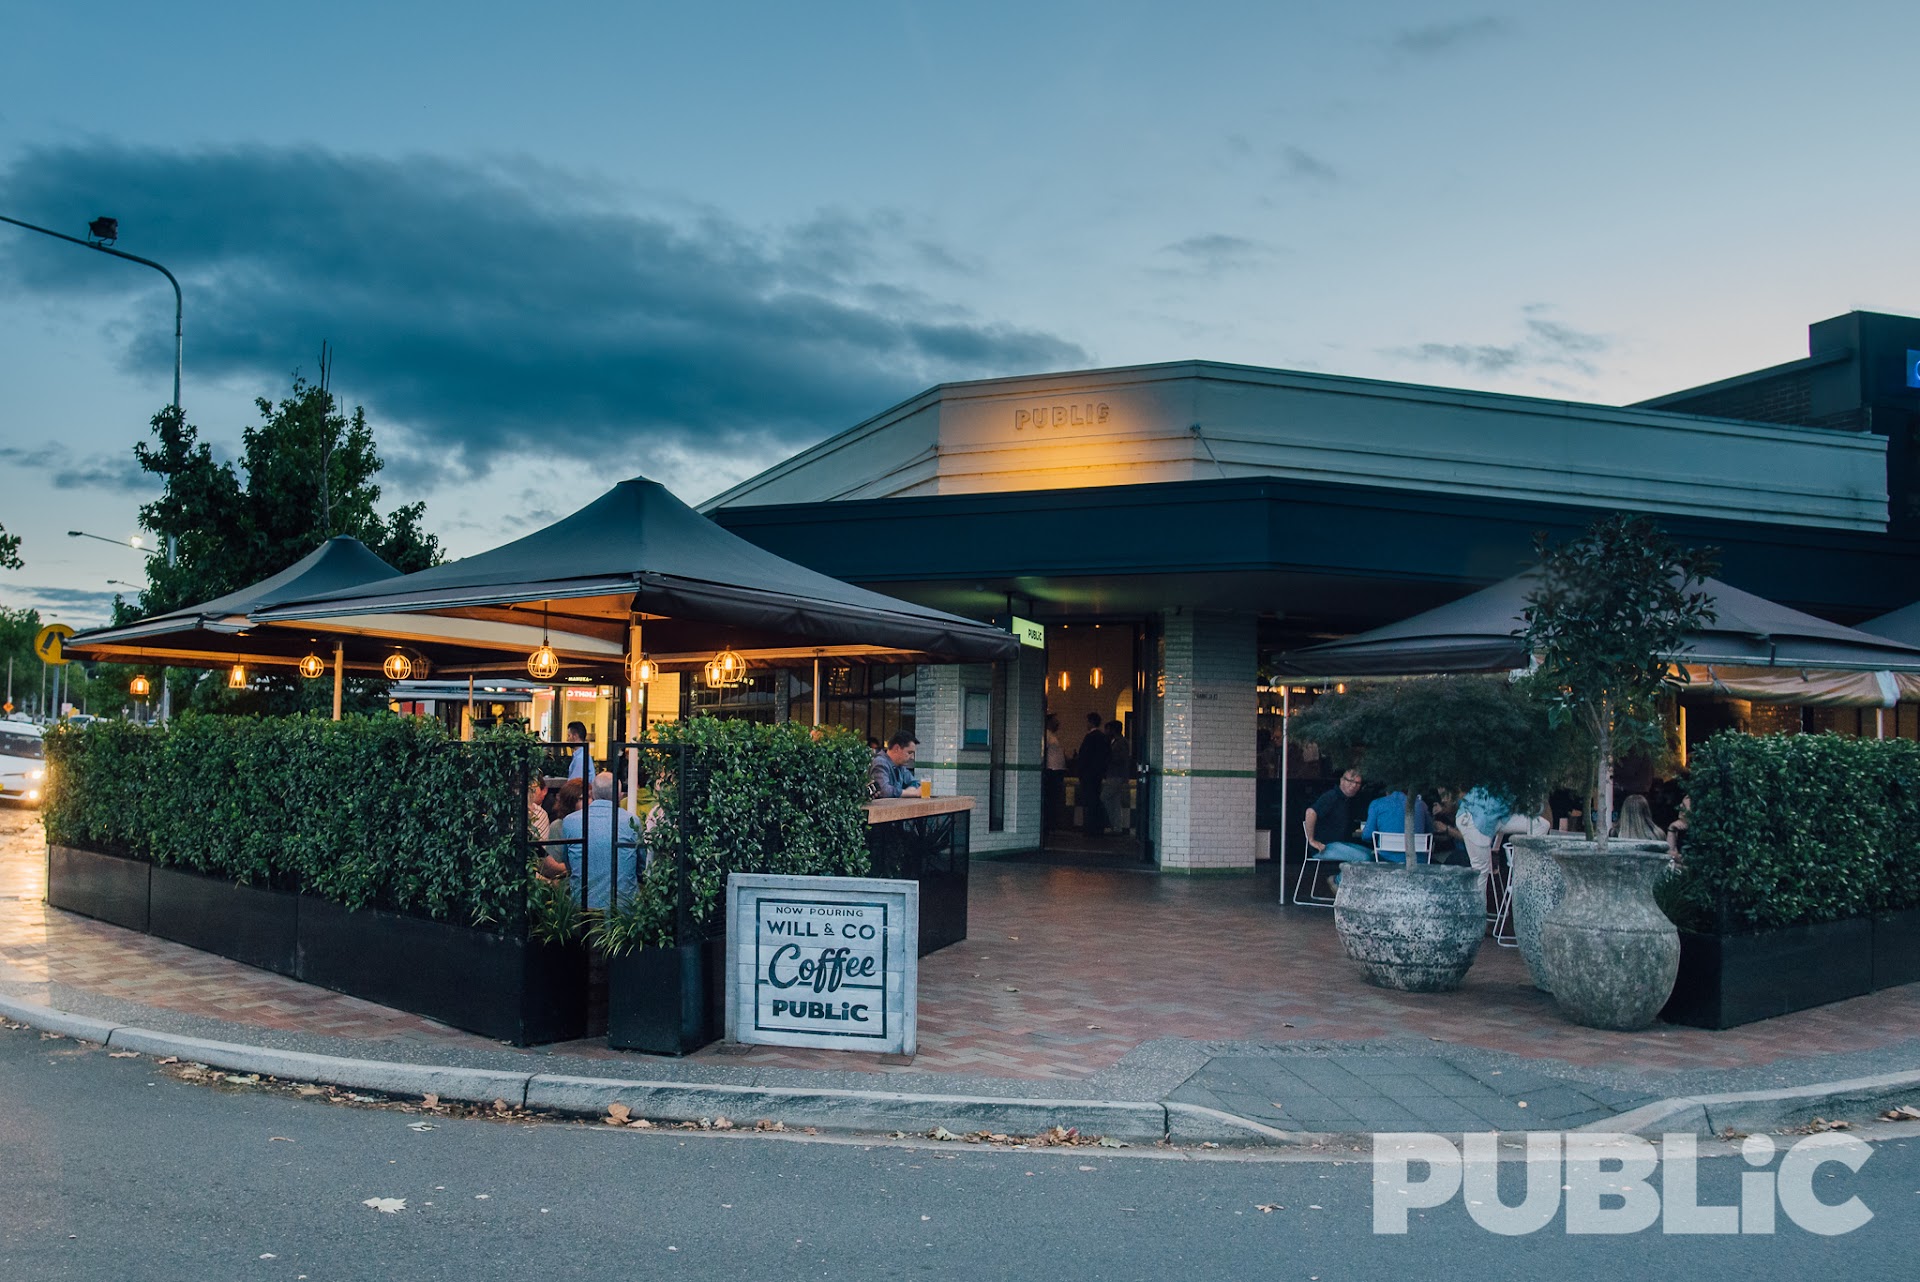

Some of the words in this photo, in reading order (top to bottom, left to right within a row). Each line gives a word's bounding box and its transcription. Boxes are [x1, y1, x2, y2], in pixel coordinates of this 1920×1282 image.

[776, 906, 803, 915] NOW
[809, 908, 864, 917] POURING
[767, 920, 818, 937] WILL
[823, 922, 835, 936] &
[841, 923, 876, 940] CO
[768, 942, 876, 994] Coffee
